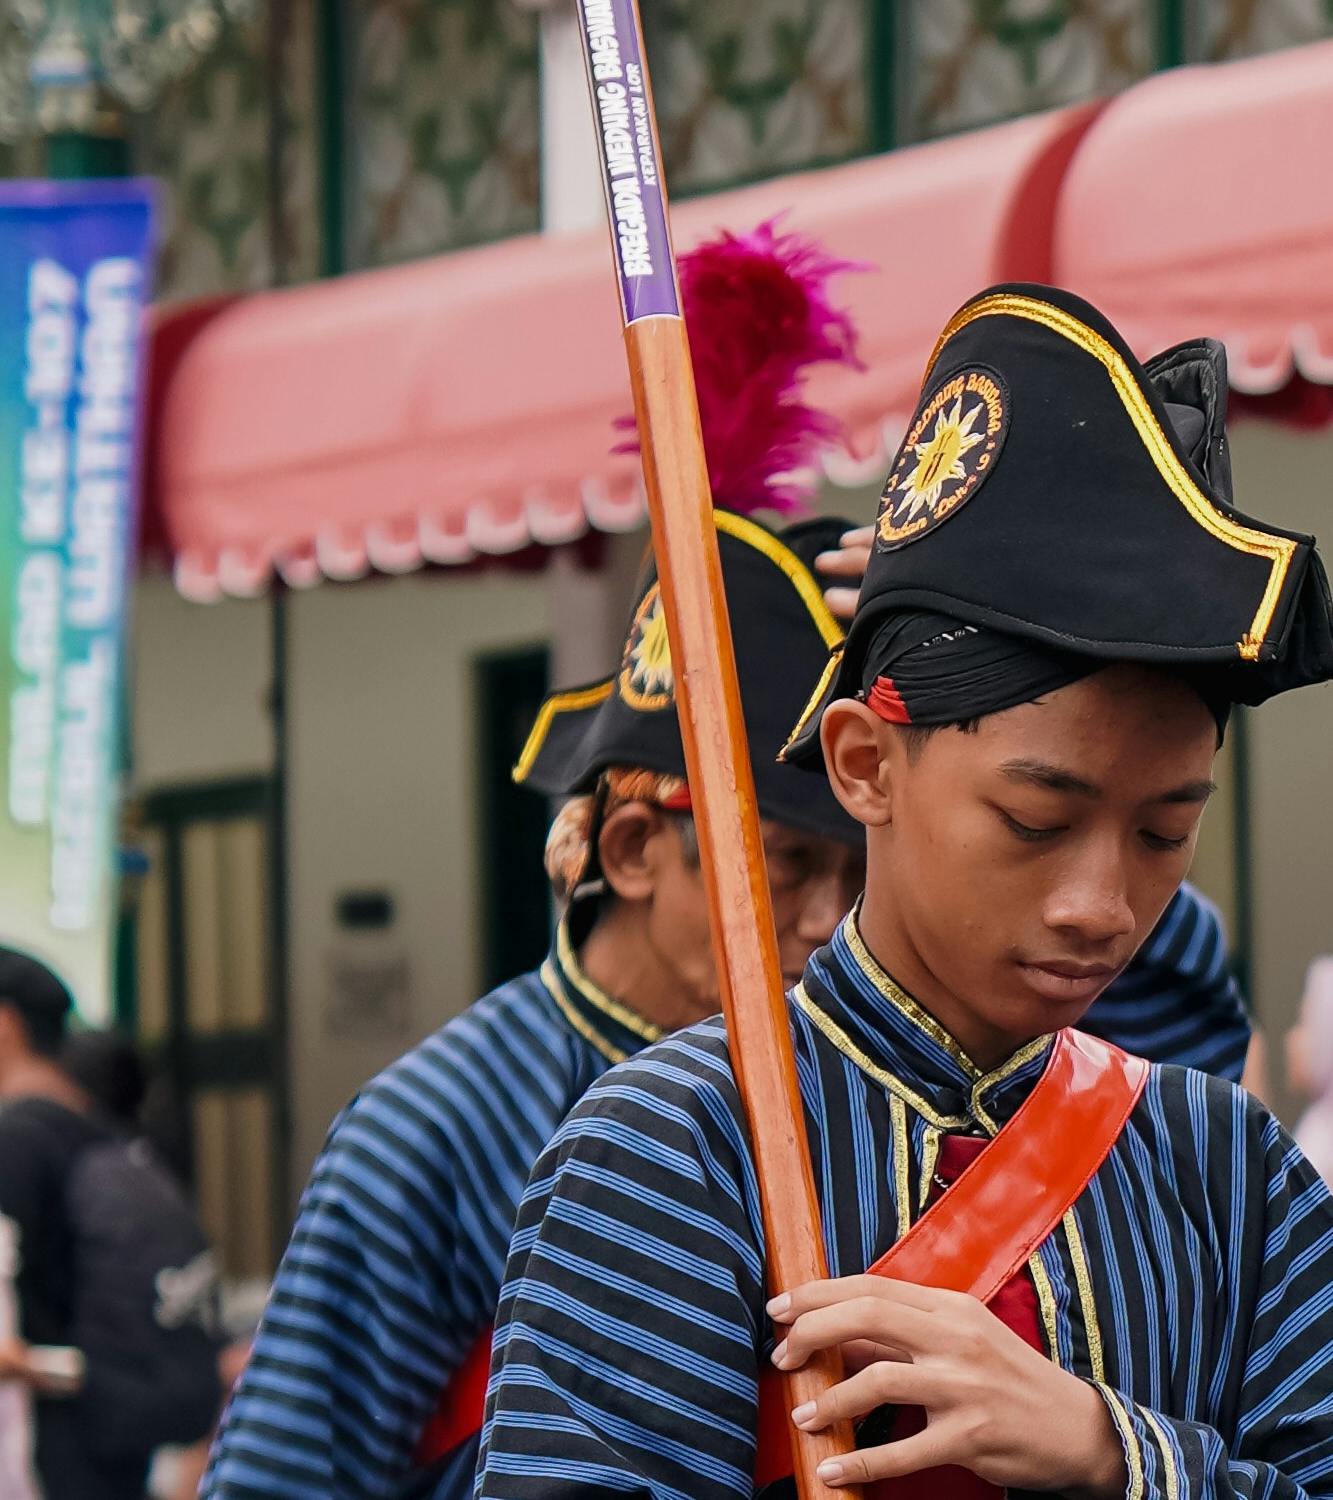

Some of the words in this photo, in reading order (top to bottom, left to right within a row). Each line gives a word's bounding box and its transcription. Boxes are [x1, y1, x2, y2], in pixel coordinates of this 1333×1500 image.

[625, 62, 643, 93] LOR
[597, 81, 637, 177] WEDUNG
[630, 96, 656, 185] KEPARAKAN
[611, 177, 653, 277] BREGADA
